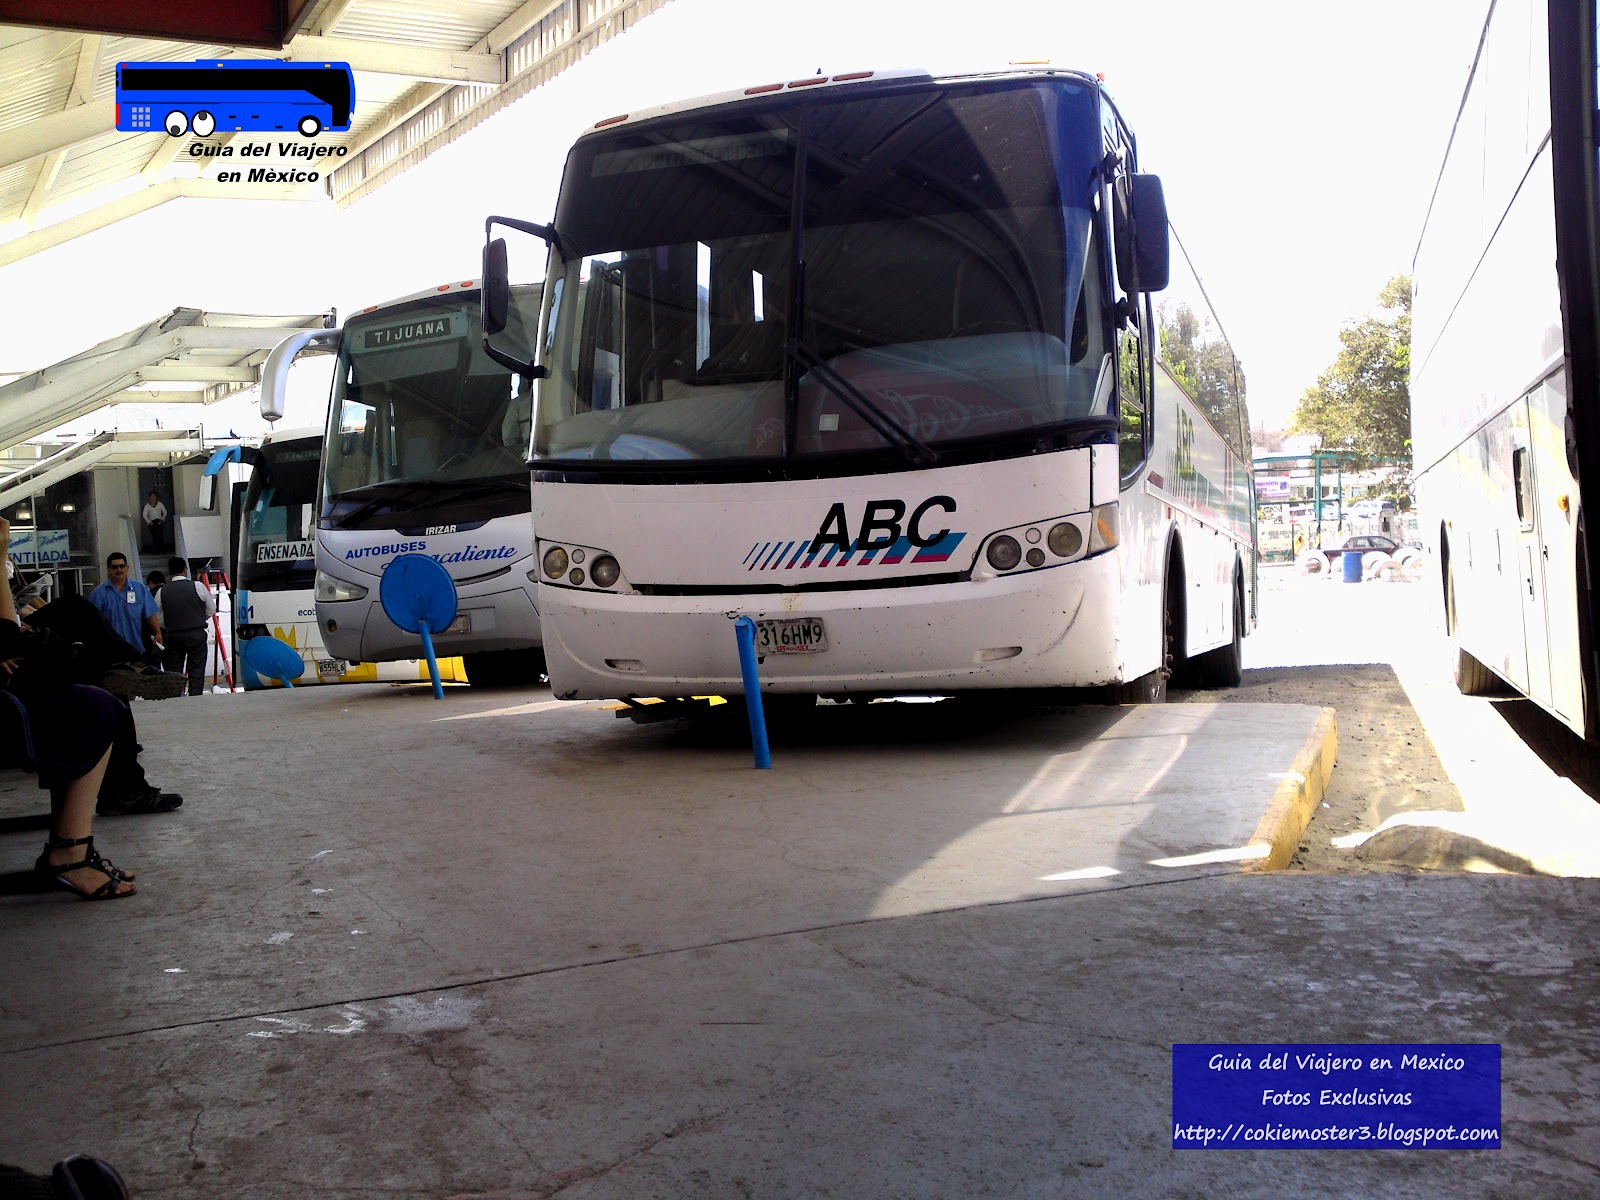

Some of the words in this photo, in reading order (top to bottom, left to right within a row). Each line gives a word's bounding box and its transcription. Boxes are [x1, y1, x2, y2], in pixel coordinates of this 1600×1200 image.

[374, 321, 444, 343] TIJUANA
[425, 524, 457, 536] IRIZAR
[807, 495, 957, 554] ABC
[9, 550, 69, 563] NTRADA
[258, 542, 315, 561] ENSENADA
[345, 541, 427, 560] AUTOBUSES
[760, 624, 822, 646] 316HM9
